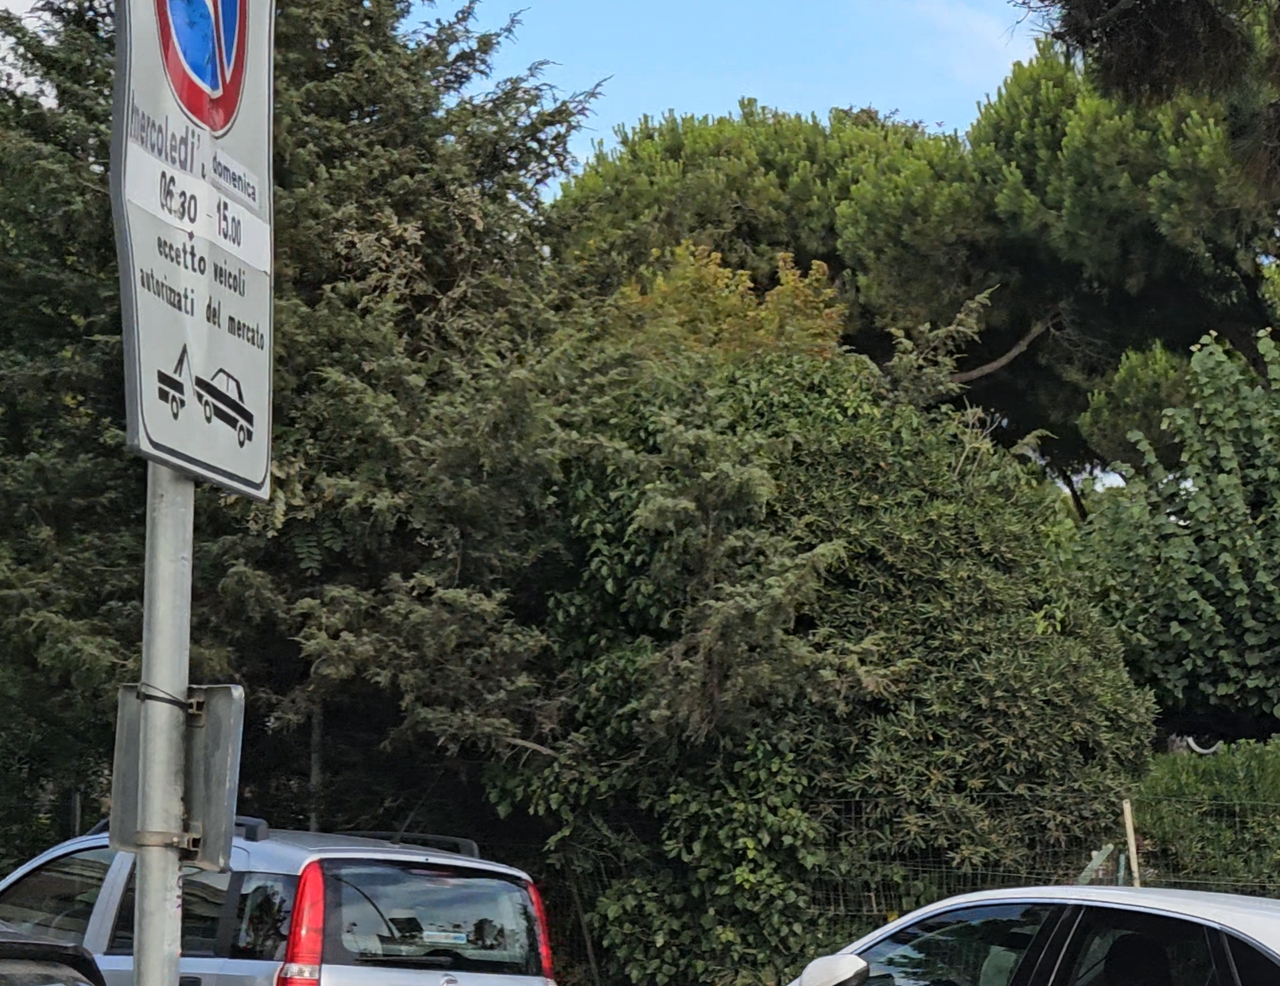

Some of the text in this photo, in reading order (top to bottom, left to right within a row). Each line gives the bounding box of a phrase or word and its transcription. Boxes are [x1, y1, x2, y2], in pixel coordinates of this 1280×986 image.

[212, 150, 257, 202] domenica
[217, 196, 242, 248] 15.00
[157, 236, 246, 298] eccetto veicoli
[139, 267, 265, 351] autorizzati del mercato
